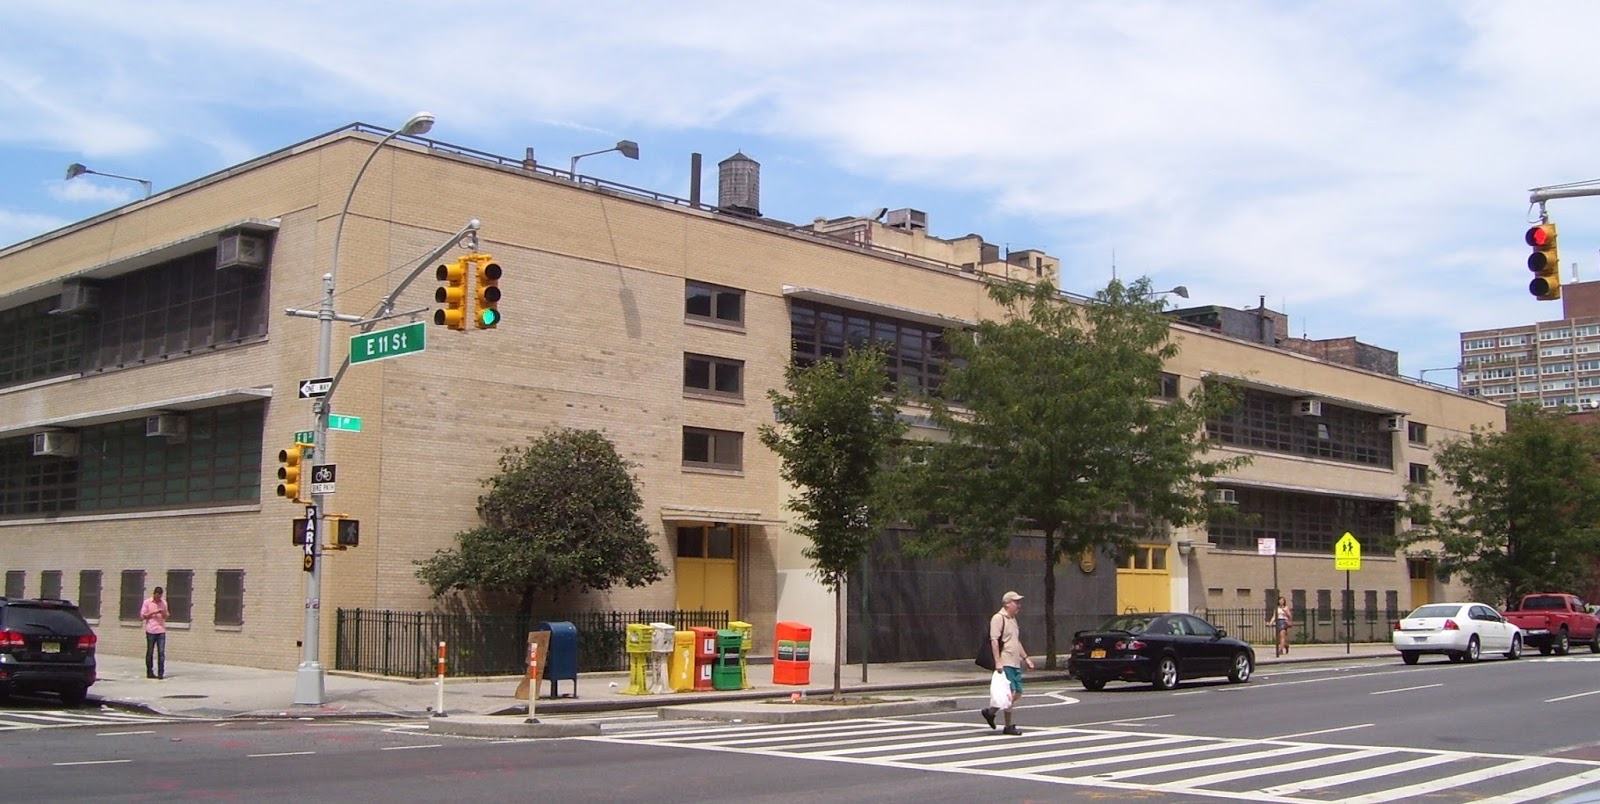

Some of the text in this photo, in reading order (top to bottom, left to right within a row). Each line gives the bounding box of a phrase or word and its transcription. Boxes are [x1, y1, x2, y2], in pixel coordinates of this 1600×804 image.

[367, 332, 407, 355] E 11 St
[305, 383, 330, 393] ONE WAY
[306, 508, 315, 555] PARK
